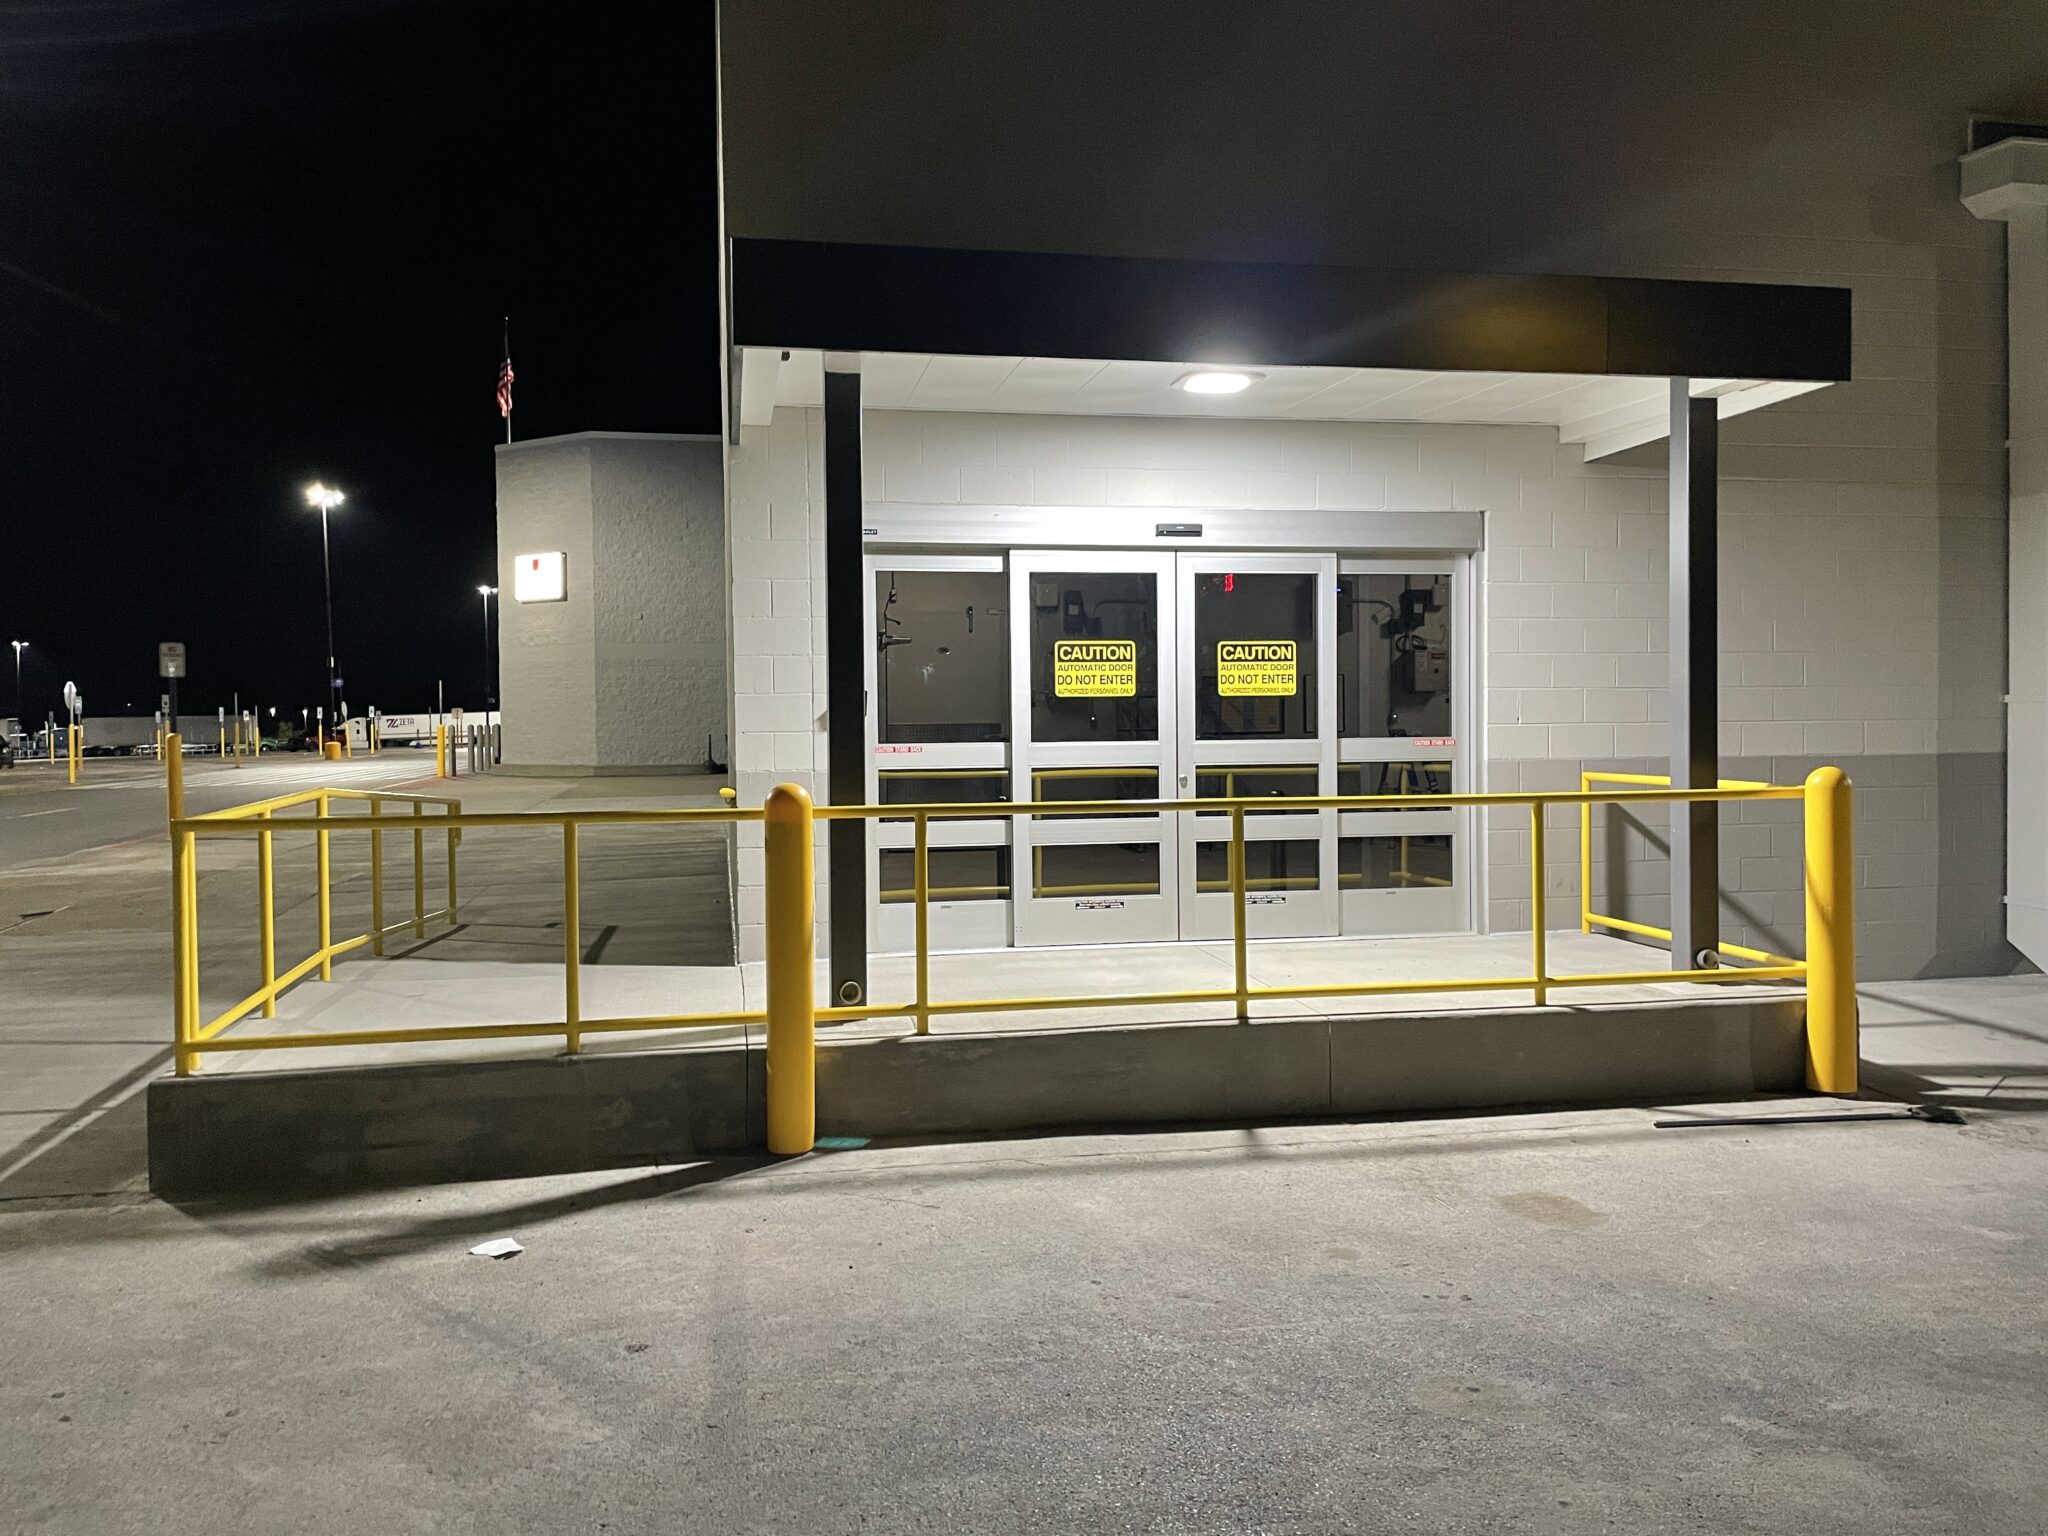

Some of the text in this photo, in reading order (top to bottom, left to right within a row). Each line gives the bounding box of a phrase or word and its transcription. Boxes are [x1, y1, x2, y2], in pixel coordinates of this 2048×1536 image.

[1059, 645, 1131, 660] CAUTION
[1222, 645, 1292, 660] CAUTION
[1058, 664, 1133, 672] AUTOMATIC DOOR
[1270, 663, 1294, 671] DOOR
[1057, 674, 1133, 685] DO NOT ENTER
[1220, 674, 1294, 685] DO NOT ENTER
[399, 718, 414, 726] ZETA
